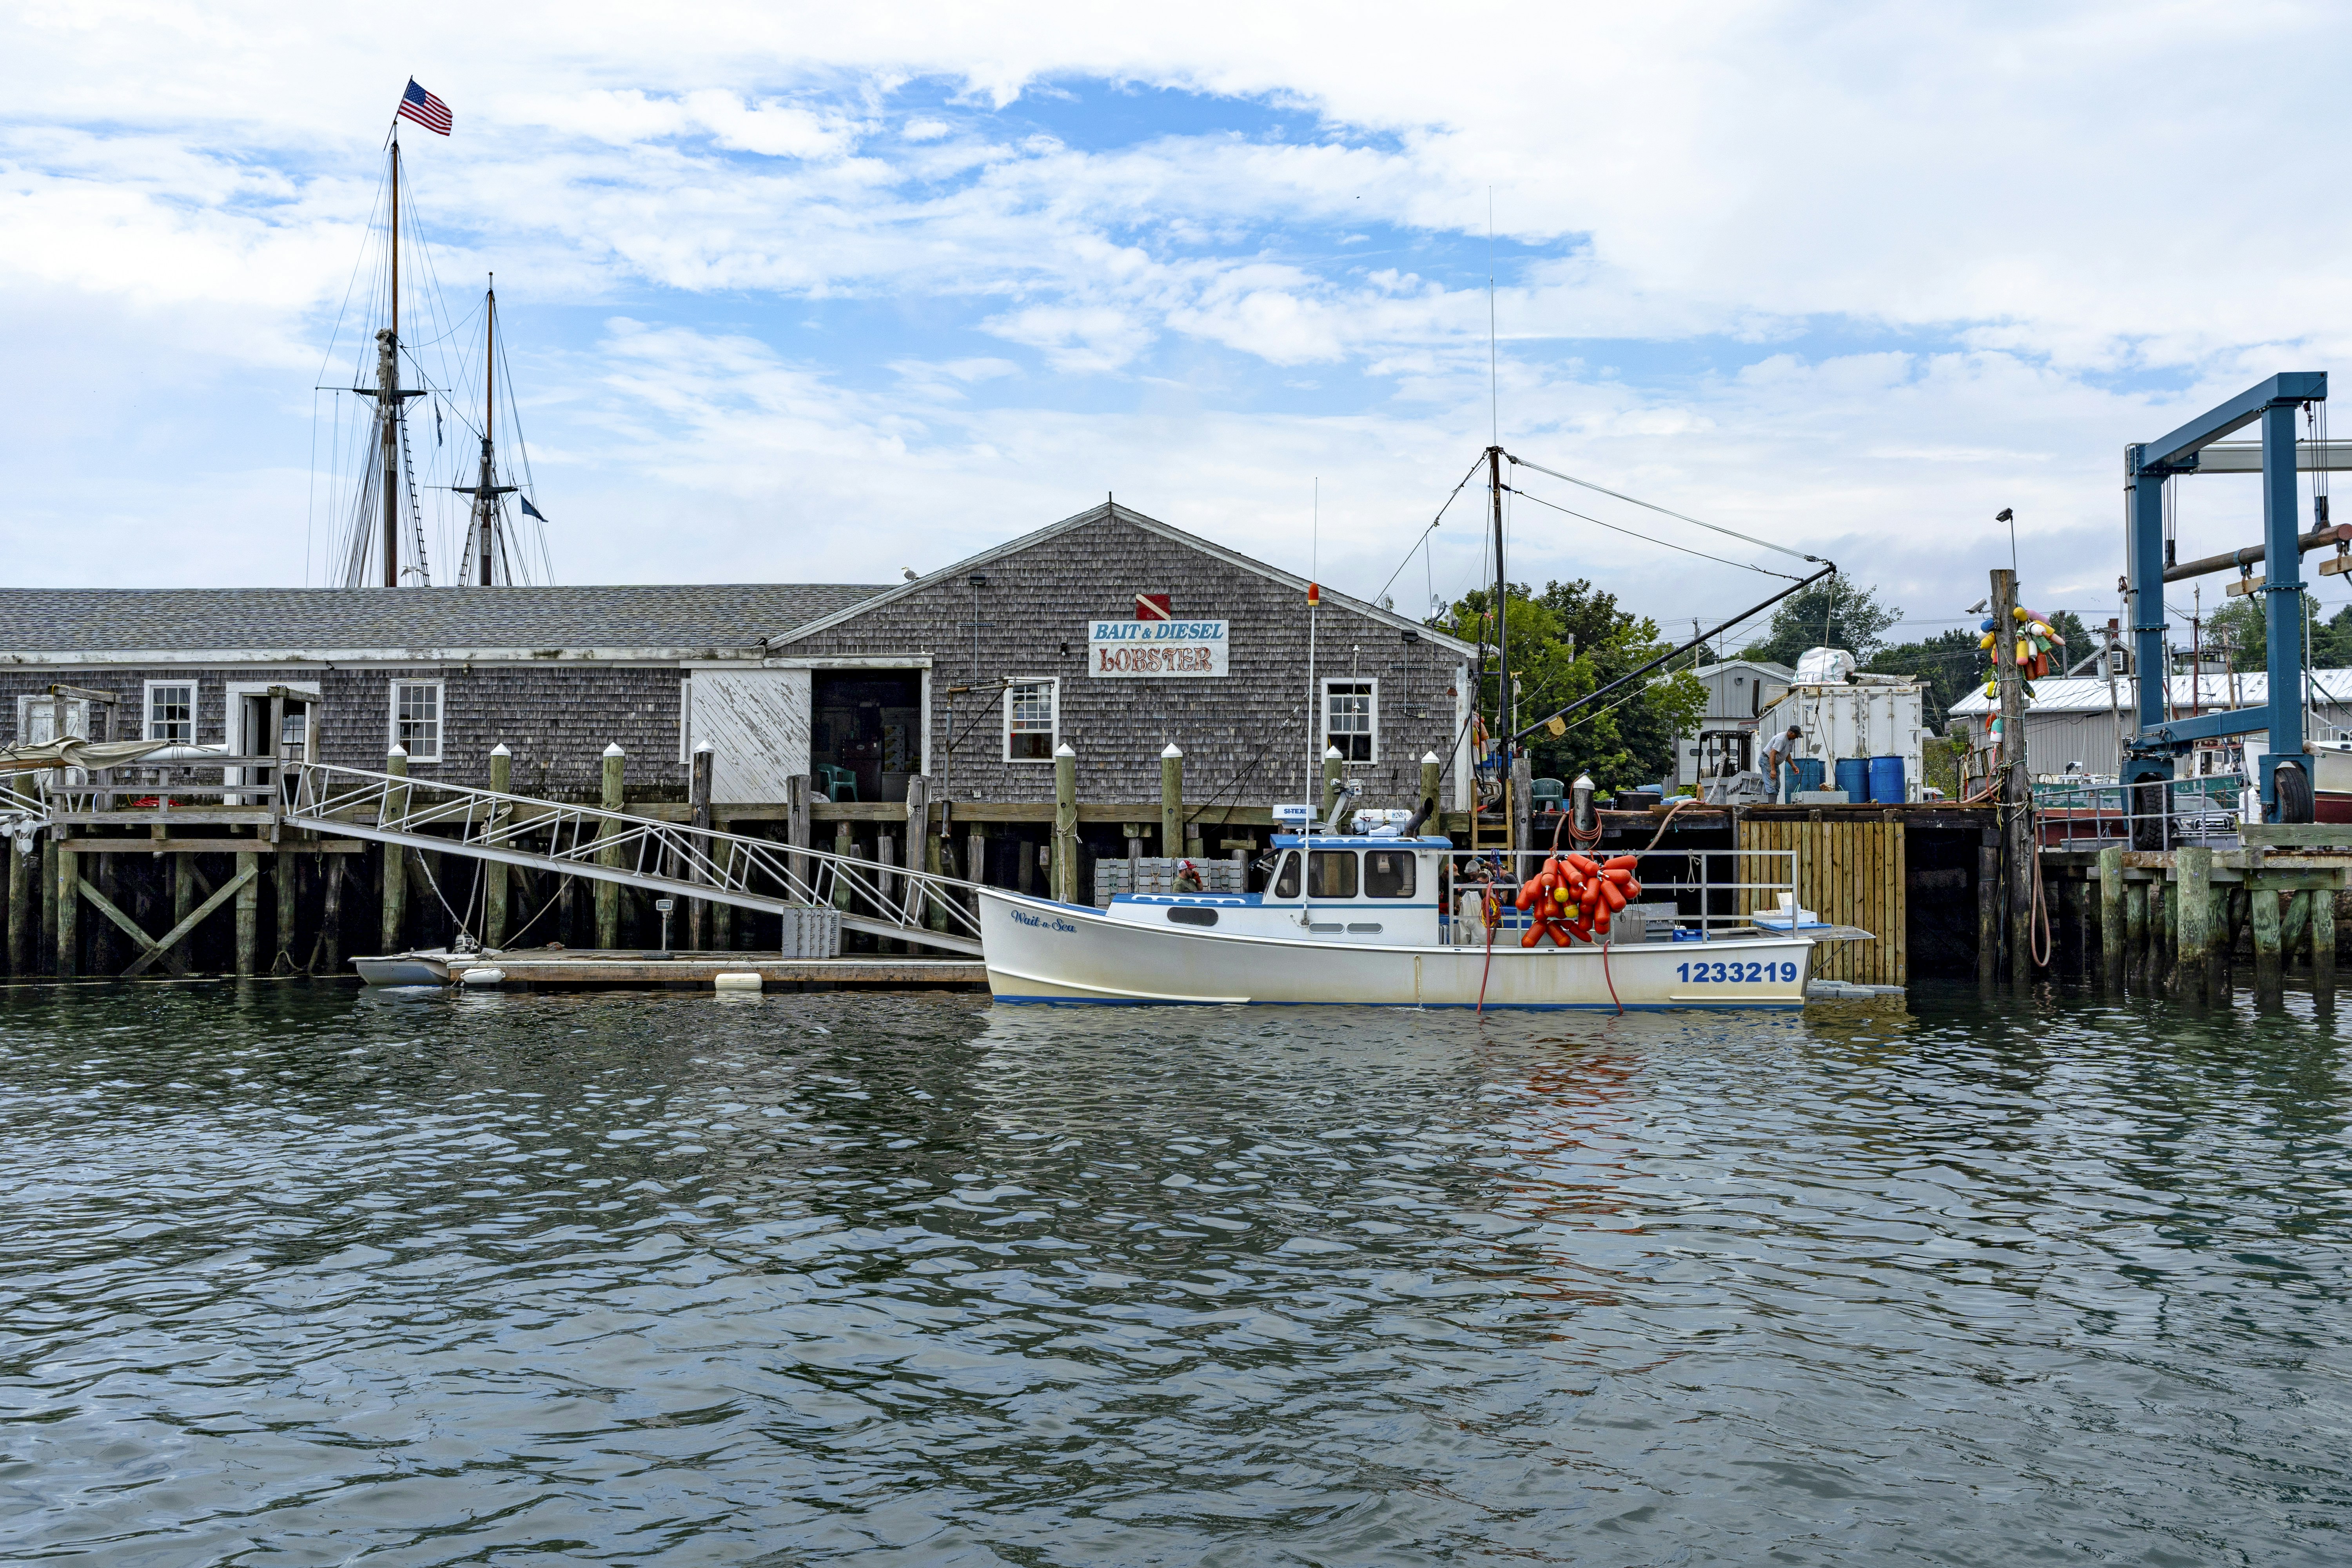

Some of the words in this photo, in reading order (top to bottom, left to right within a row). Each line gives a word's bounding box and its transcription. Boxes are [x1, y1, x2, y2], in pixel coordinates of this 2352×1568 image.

[1094, 624, 1141, 639] BAIT
[1142, 628, 1152, 639] &
[1155, 624, 1223, 639] DIESEL
[1099, 647, 1212, 671] LOBSTER
[1677, 962, 1797, 982] 1233219
